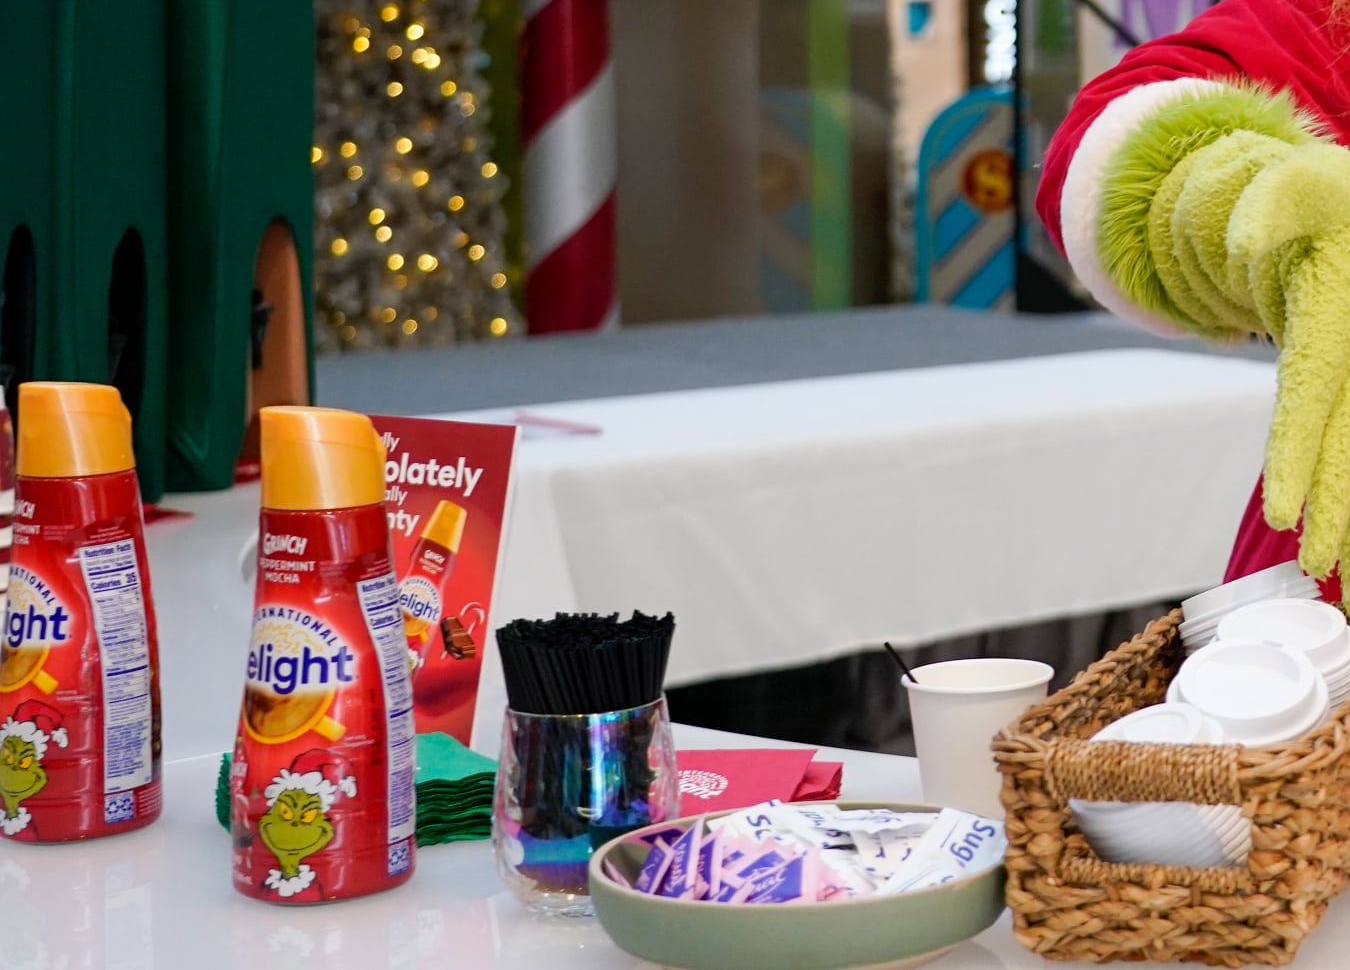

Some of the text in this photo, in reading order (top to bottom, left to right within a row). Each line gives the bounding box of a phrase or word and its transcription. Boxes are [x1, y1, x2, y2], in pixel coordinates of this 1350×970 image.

[384, 452, 484, 497] olately
[387, 509, 420, 537] nty
[263, 533, 308, 555] GRINCH
[264, 571, 300, 584] MOCHA
[4, 599, 69, 648] ight
[399, 592, 441, 622] elight
[246, 643, 354, 695] elight
[949, 819, 997, 868] Sug
